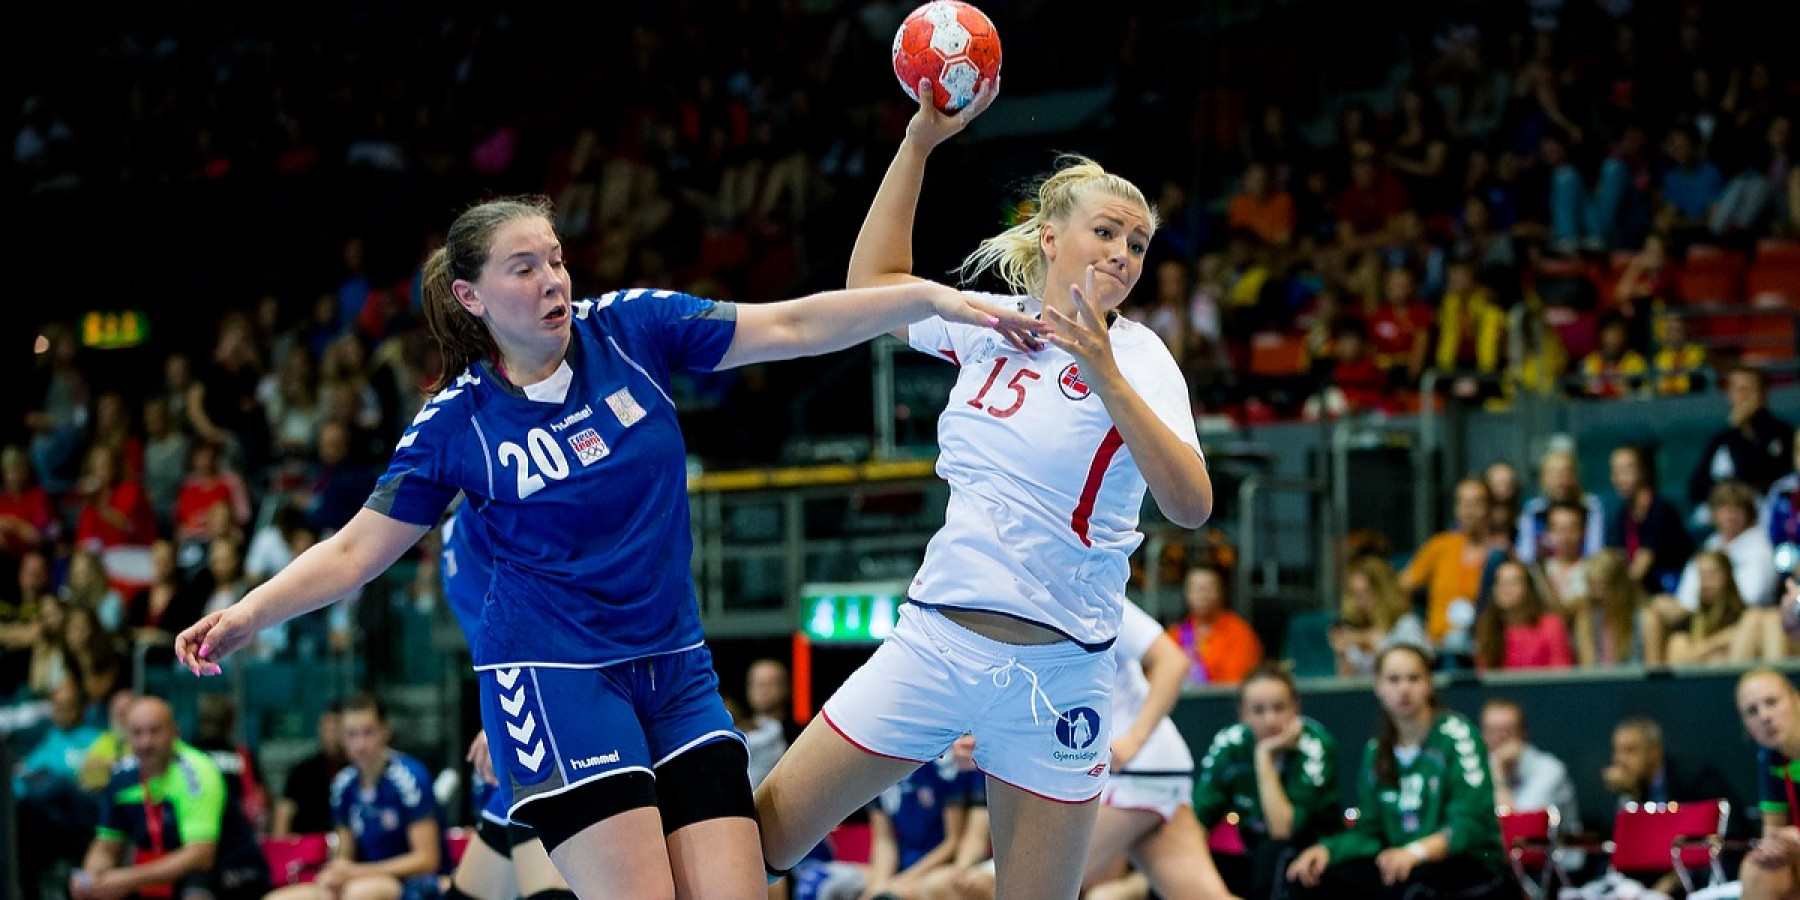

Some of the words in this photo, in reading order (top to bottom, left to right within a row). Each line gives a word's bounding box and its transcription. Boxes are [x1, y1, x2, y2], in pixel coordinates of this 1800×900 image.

[966, 356, 1041, 418] 15
[550, 404, 593, 432] hummel
[498, 428, 570, 500] 20
[569, 749, 620, 770] hummel
